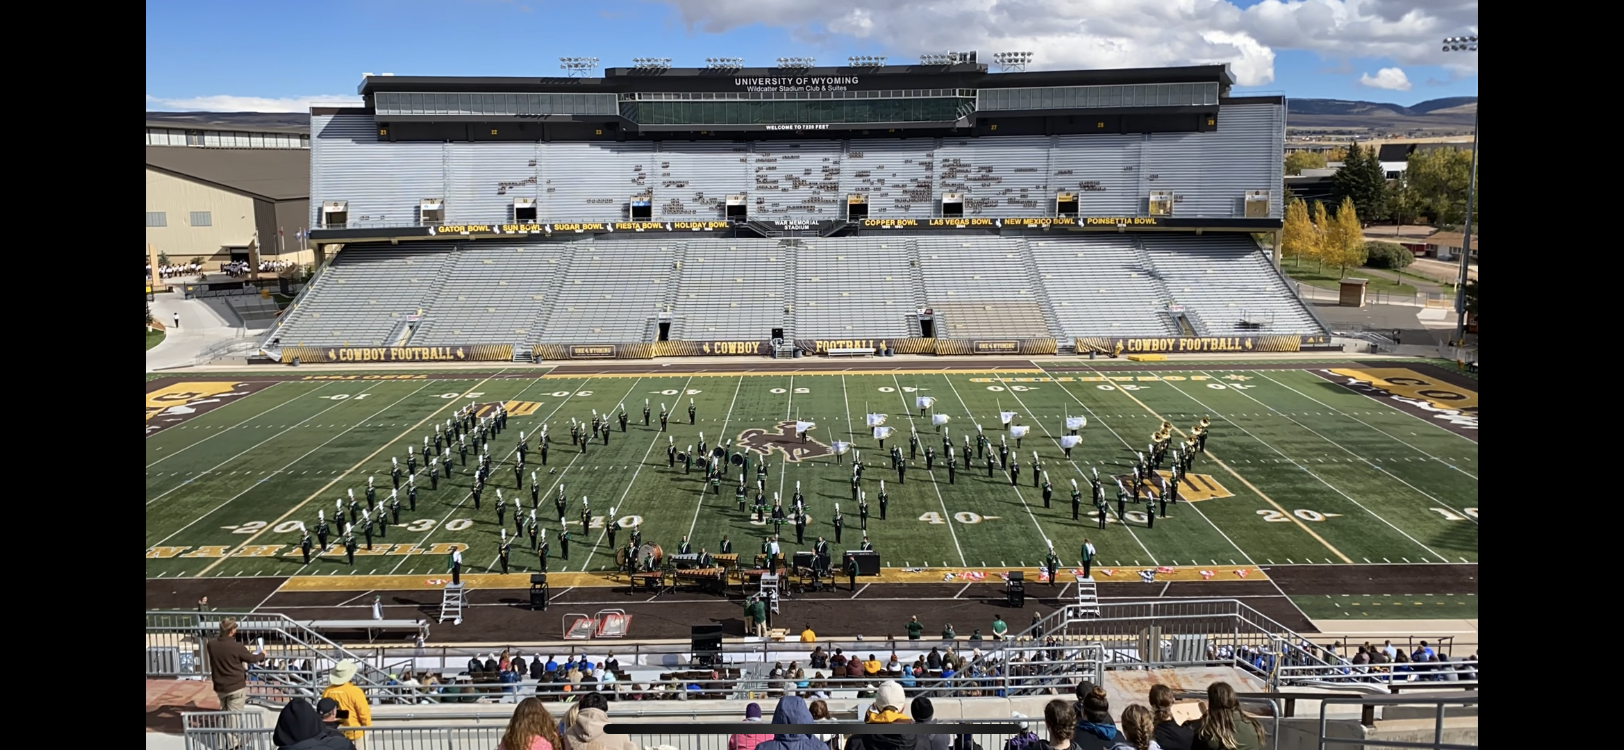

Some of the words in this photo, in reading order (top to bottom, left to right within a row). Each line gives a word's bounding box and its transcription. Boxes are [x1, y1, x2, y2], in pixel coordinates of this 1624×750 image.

[734, 77, 793, 86] UNIVERSITY
[795, 77, 809, 86] OF
[811, 76, 859, 85] WYOMING
[438, 225, 465, 233] GATOR
[467, 224, 491, 232] BOWL
[502, 223, 517, 231] SUN
[518, 223, 543, 231] BOWL
[554, 223, 580, 231] SUGAR
[582, 222, 604, 230] BOWL
[615, 222, 640, 230] FIESTA
[642, 221, 663, 229] BOWL
[674, 221, 707, 229] HOLIDAY
[714, 341, 760, 354] COWBOY
[1127, 338, 1176, 351] COWBOY
[1179, 337, 1242, 351] FOOTBALL
[340, 347, 387, 361] COWBOY
[390, 347, 454, 361] FOOTBALL
[918, 511, 983, 524] 40
[1255, 509, 1326, 522] 20
[231, 520, 304, 534] 20
[407, 518, 473, 532] 30
